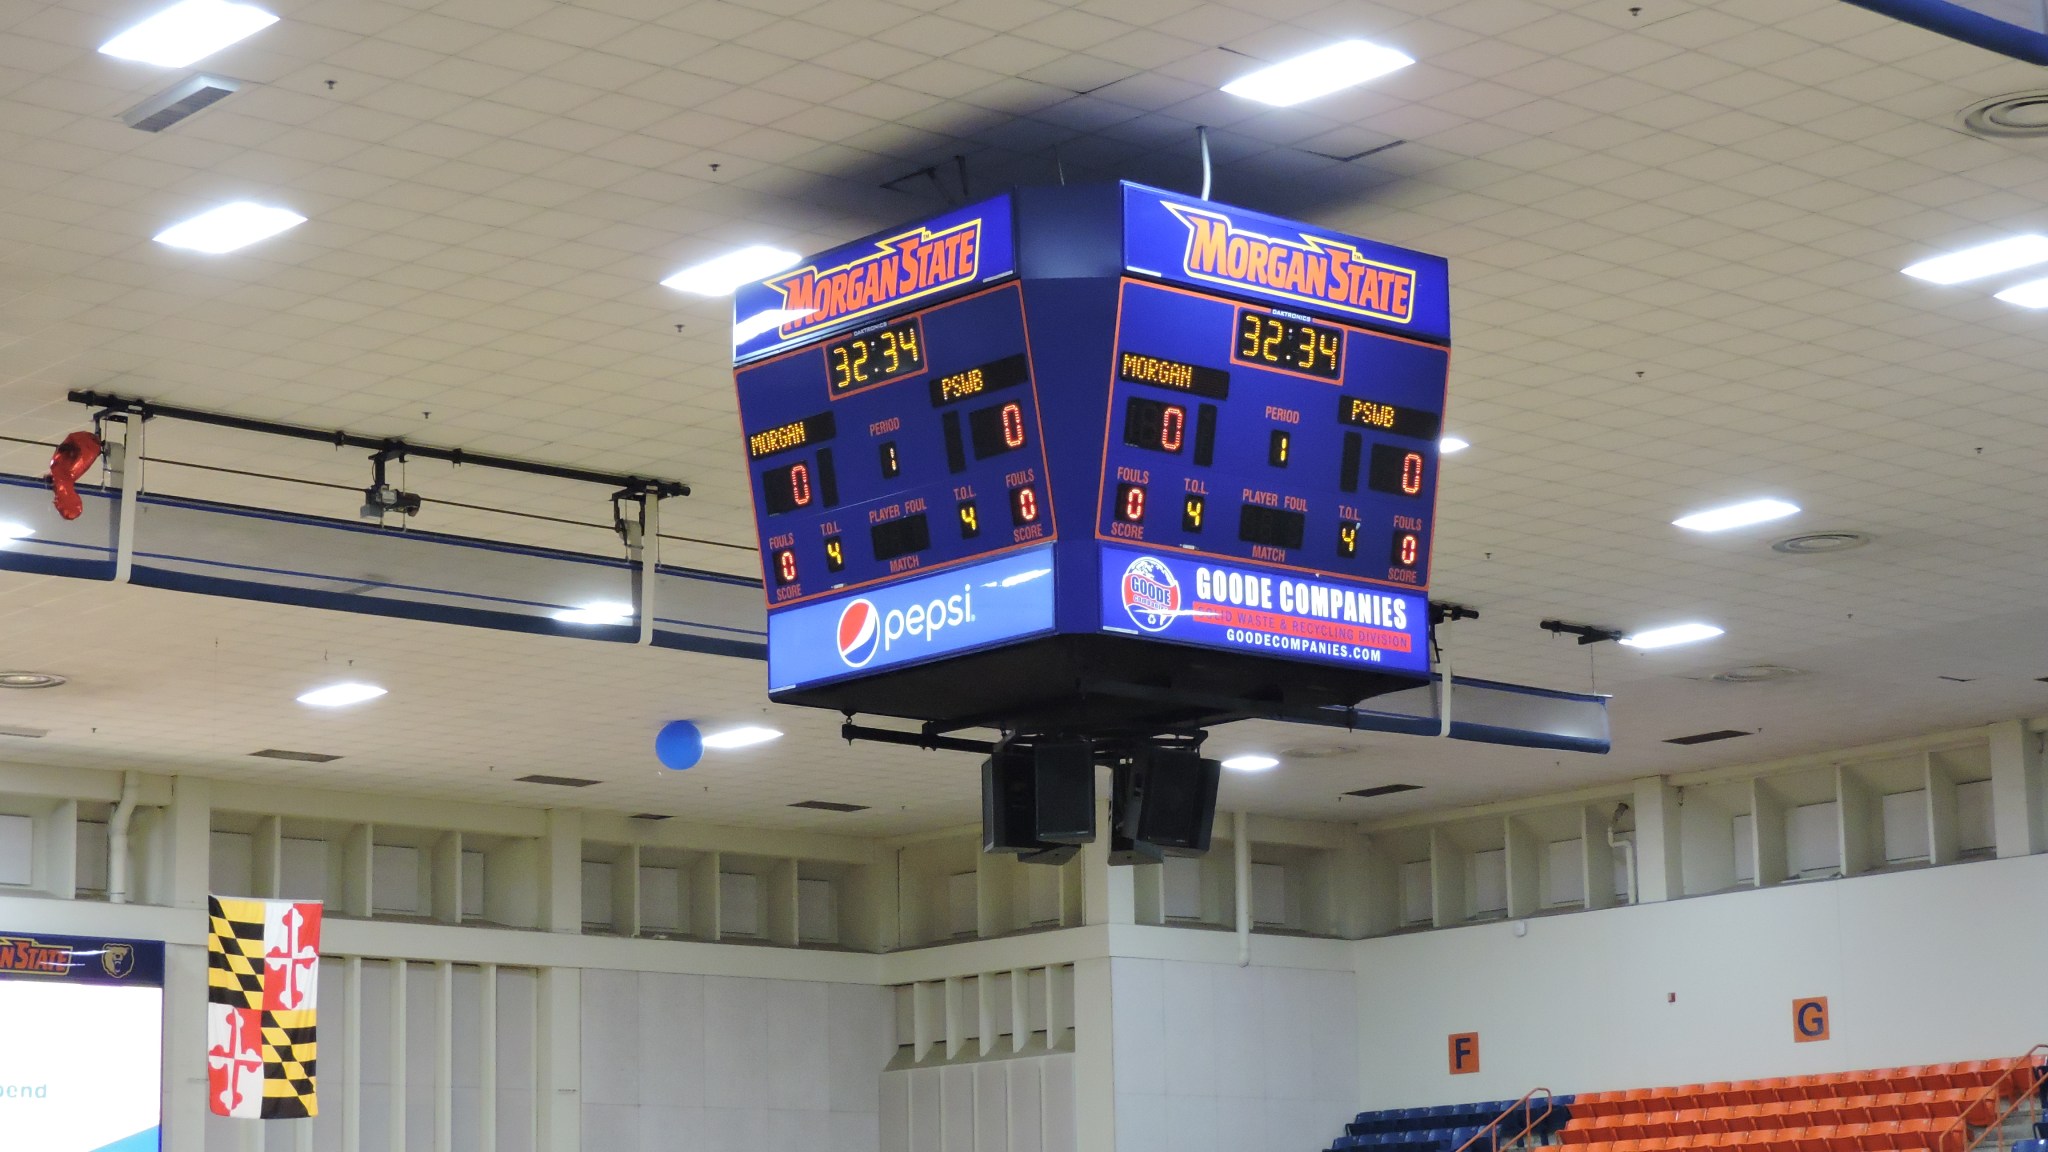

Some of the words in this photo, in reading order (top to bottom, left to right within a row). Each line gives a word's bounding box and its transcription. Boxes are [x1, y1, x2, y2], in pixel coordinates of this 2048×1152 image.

[783, 255, 899, 331] MORGAN
[898, 229, 975, 294] STATE
[1187, 215, 1327, 297] MORGAN
[1324, 247, 1411, 316] STATE
[853, 321, 888, 337] DAKTRONICS
[1271, 308, 1312, 323] DAKTRONICS
[1243, 315, 1338, 370] 32:34
[833, 328, 919, 388] 32:34
[1121, 353, 1193, 389] MORGAN
[941, 368, 984, 400] PSWB
[869, 417, 900, 437] PERIOD
[1002, 403, 1023, 447] 0
[1265, 405, 1300, 424] PERIOD
[1351, 399, 1396, 428] PSWB
[750, 421, 806, 457] MORGAN
[1162, 407, 1183, 450] 0
[889, 447, 897, 471] 1
[1280, 437, 1287, 462] 1
[791, 465, 810, 505] 0
[1005, 468, 1035, 488] FOULS
[1117, 466, 1149, 485] FOULS
[1402, 453, 1422, 494] 0
[869, 504, 901, 524] PLAYER
[904, 497, 927, 516] FOUL
[1020, 489, 1034, 520] 0
[1126, 488, 1142, 519] 0
[1187, 501, 1201, 527] 4
[1242, 488, 1278, 508] PLAYER
[1284, 495, 1308, 512] FOUL
[961, 506, 977, 531] 4
[1111, 522, 1144, 540] SCORE
[1394, 515, 1422, 531] FOULS
[769, 532, 794, 550] FOULS
[1013, 524, 1043, 543] SCORE
[1341, 527, 1355, 552] 4
[827, 542, 842, 564] 4
[890, 555, 919, 573] MATCH
[1252, 545, 1286, 563] MATCH
[1402, 535, 1415, 564] 0
[781, 551, 796, 580] 0
[1388, 567, 1417, 584] SCORE
[776, 584, 802, 602] SCORE
[1131, 575, 1171, 606] GOODE
[1196, 567, 1273, 610] GOODE
[1279, 580, 1408, 630] COMPANIES
[1237, 611, 1275, 629] WASTE
[1279, 618, 1287, 629] &
[1292, 621, 1354, 640] RECYCLING
[1358, 632, 1408, 649] DIVISION
[1226, 628, 1381, 662] GOODECOMPANIES.COM
[14, 941, 68, 972] STATE
[1797, 1002, 1824, 1037] G
[1455, 1037, 1471, 1069] F
